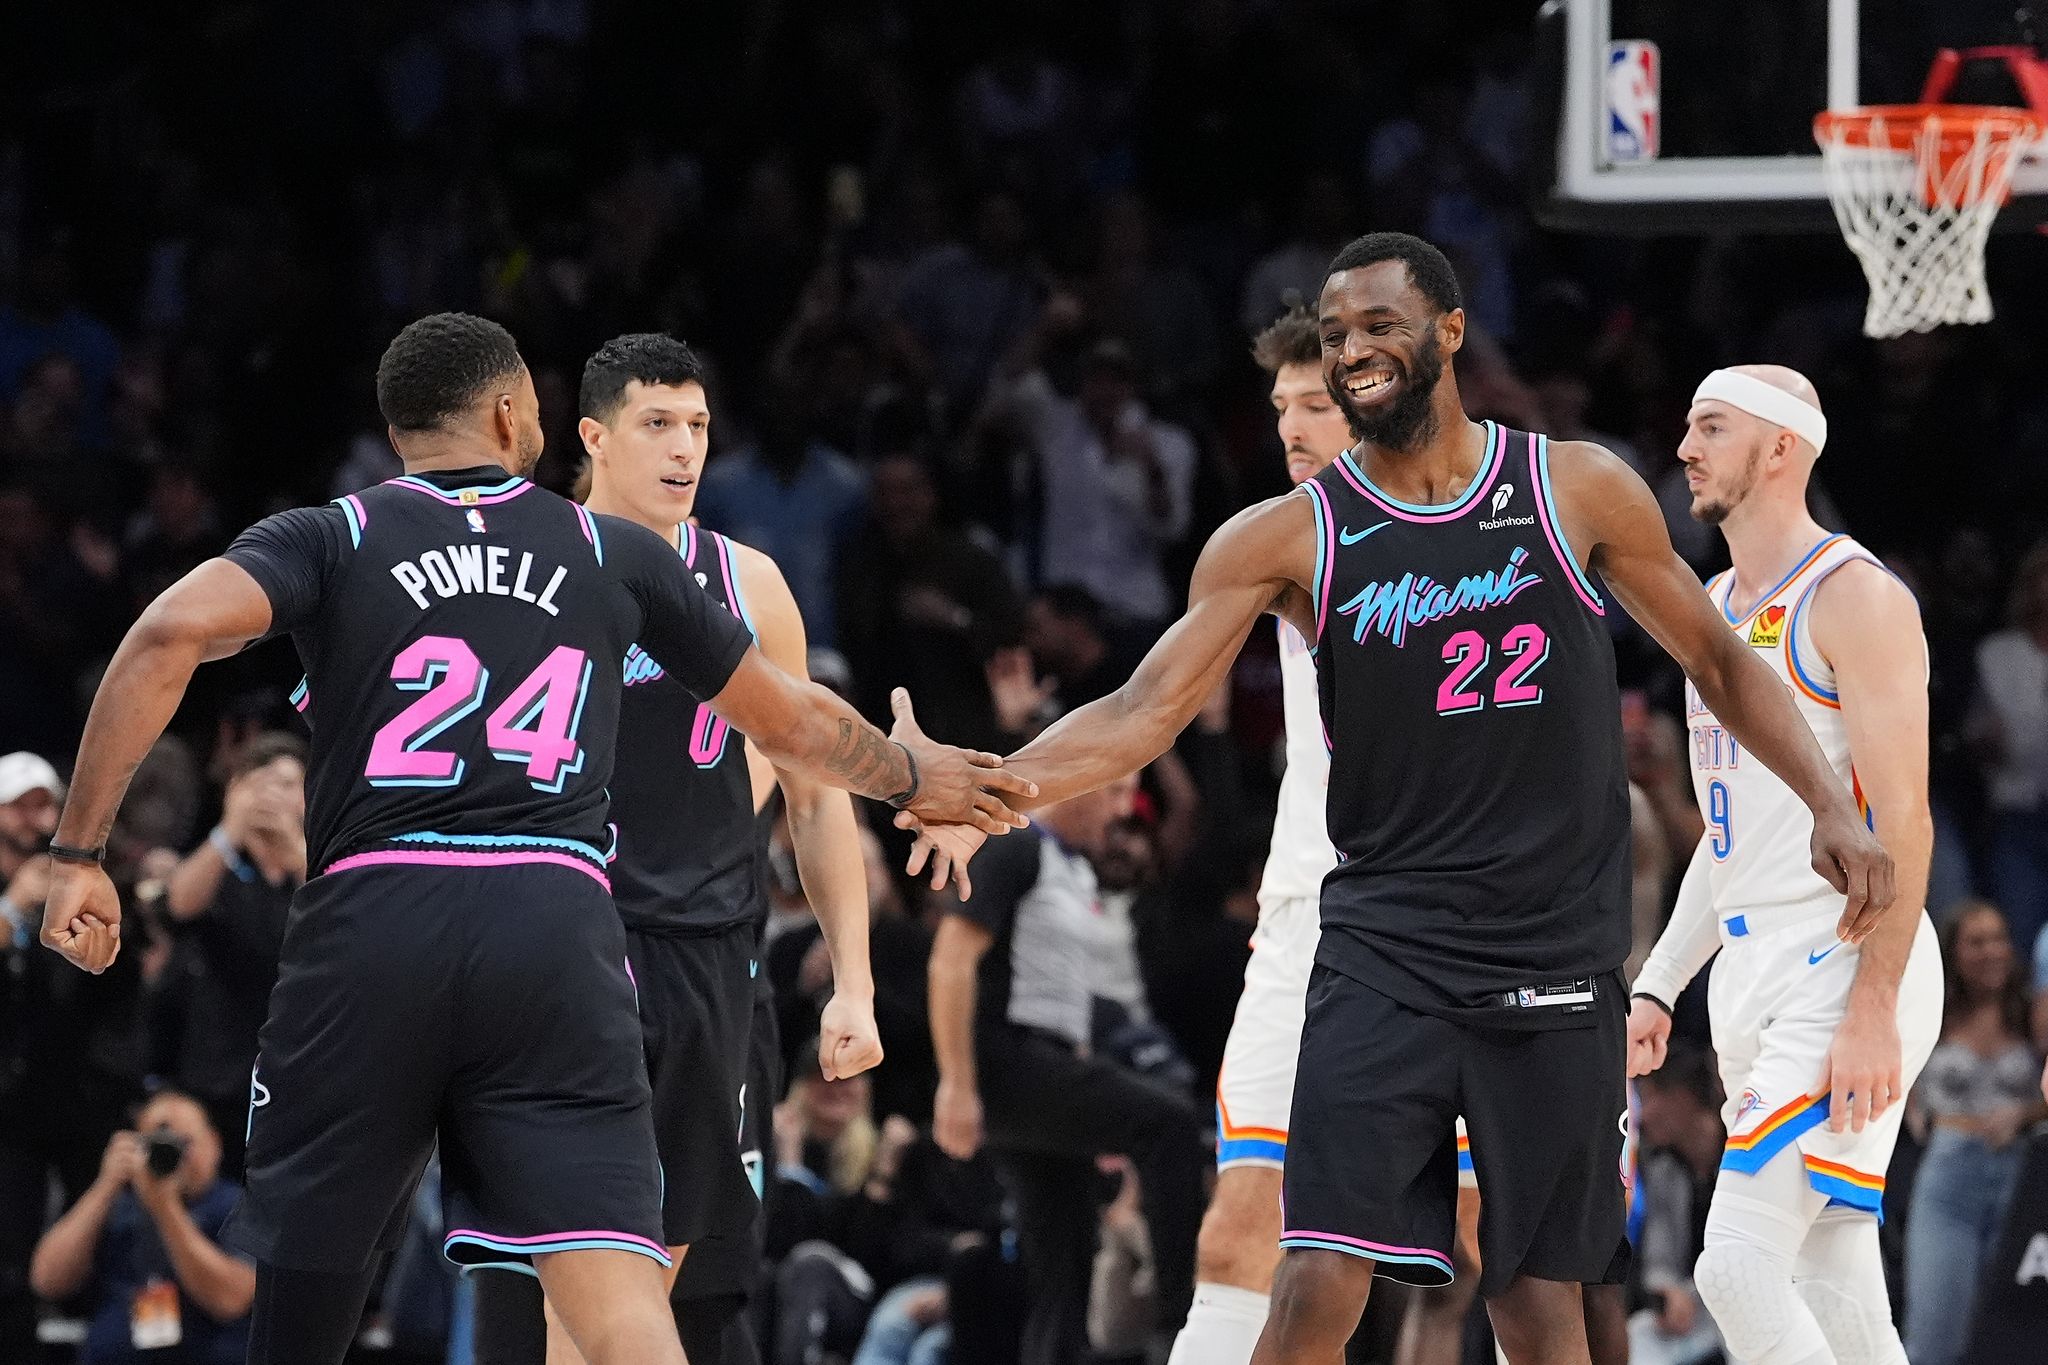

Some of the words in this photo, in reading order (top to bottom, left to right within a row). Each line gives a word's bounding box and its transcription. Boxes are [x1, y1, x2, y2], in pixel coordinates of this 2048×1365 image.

[1479, 515, 1535, 530] Robinhood
[390, 544, 568, 617] POWELL
[1336, 545, 1543, 648] Miami
[1436, 623, 1550, 716] 22
[364, 635, 593, 793] 24
[1692, 726, 1739, 770] CITY
[1709, 777, 1735, 864] 9
